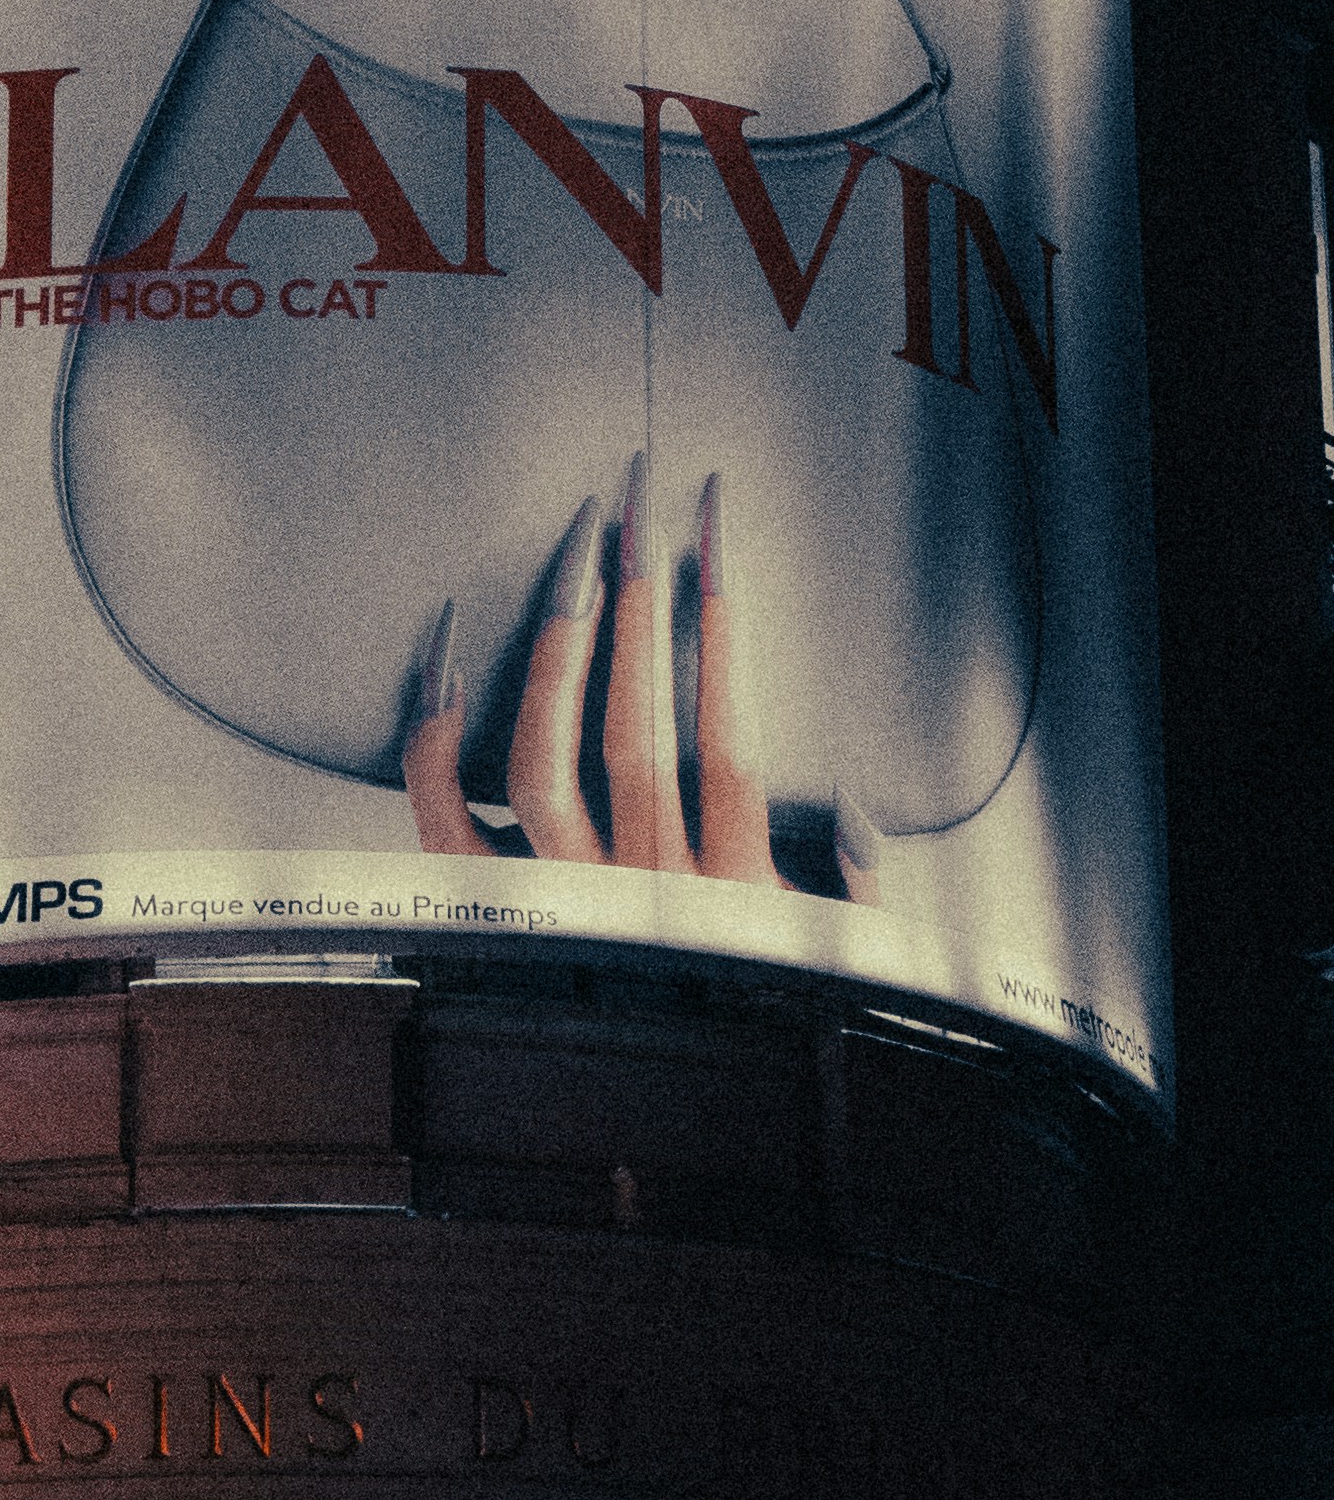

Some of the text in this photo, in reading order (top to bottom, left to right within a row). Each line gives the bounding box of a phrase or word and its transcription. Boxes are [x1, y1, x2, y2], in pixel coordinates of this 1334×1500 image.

[97, 277, 265, 327] HOBO
[278, 277, 389, 321] CAT
[131, 893, 558, 931] Marque vendue au Printemps
